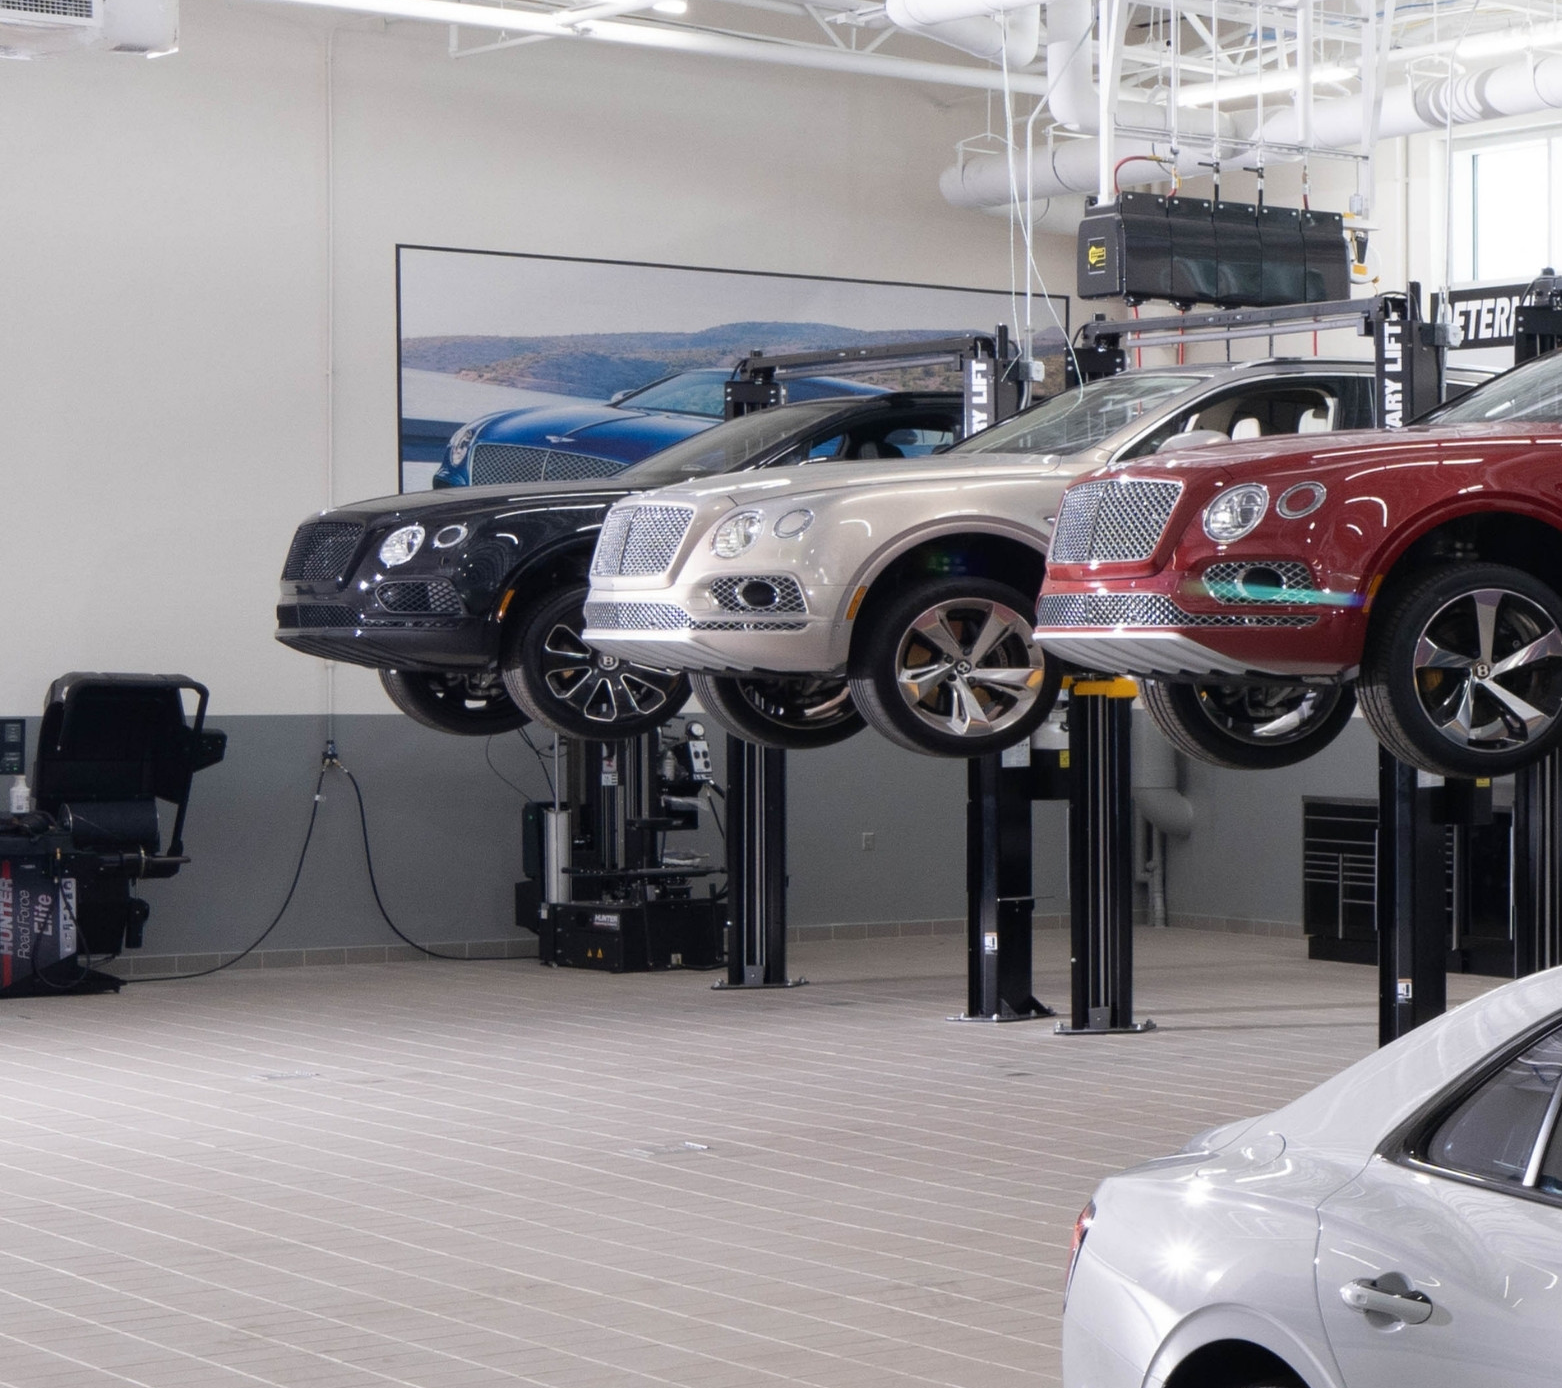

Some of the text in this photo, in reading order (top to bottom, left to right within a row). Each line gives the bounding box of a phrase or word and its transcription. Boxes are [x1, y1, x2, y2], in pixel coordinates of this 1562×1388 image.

[1384, 322, 1402, 372] LIFT
[971, 360, 988, 404] LIFT
[0, 878, 13, 955] HUNTER
[17, 890, 31, 960] Road Force
[33, 894, 53, 936] Elite
